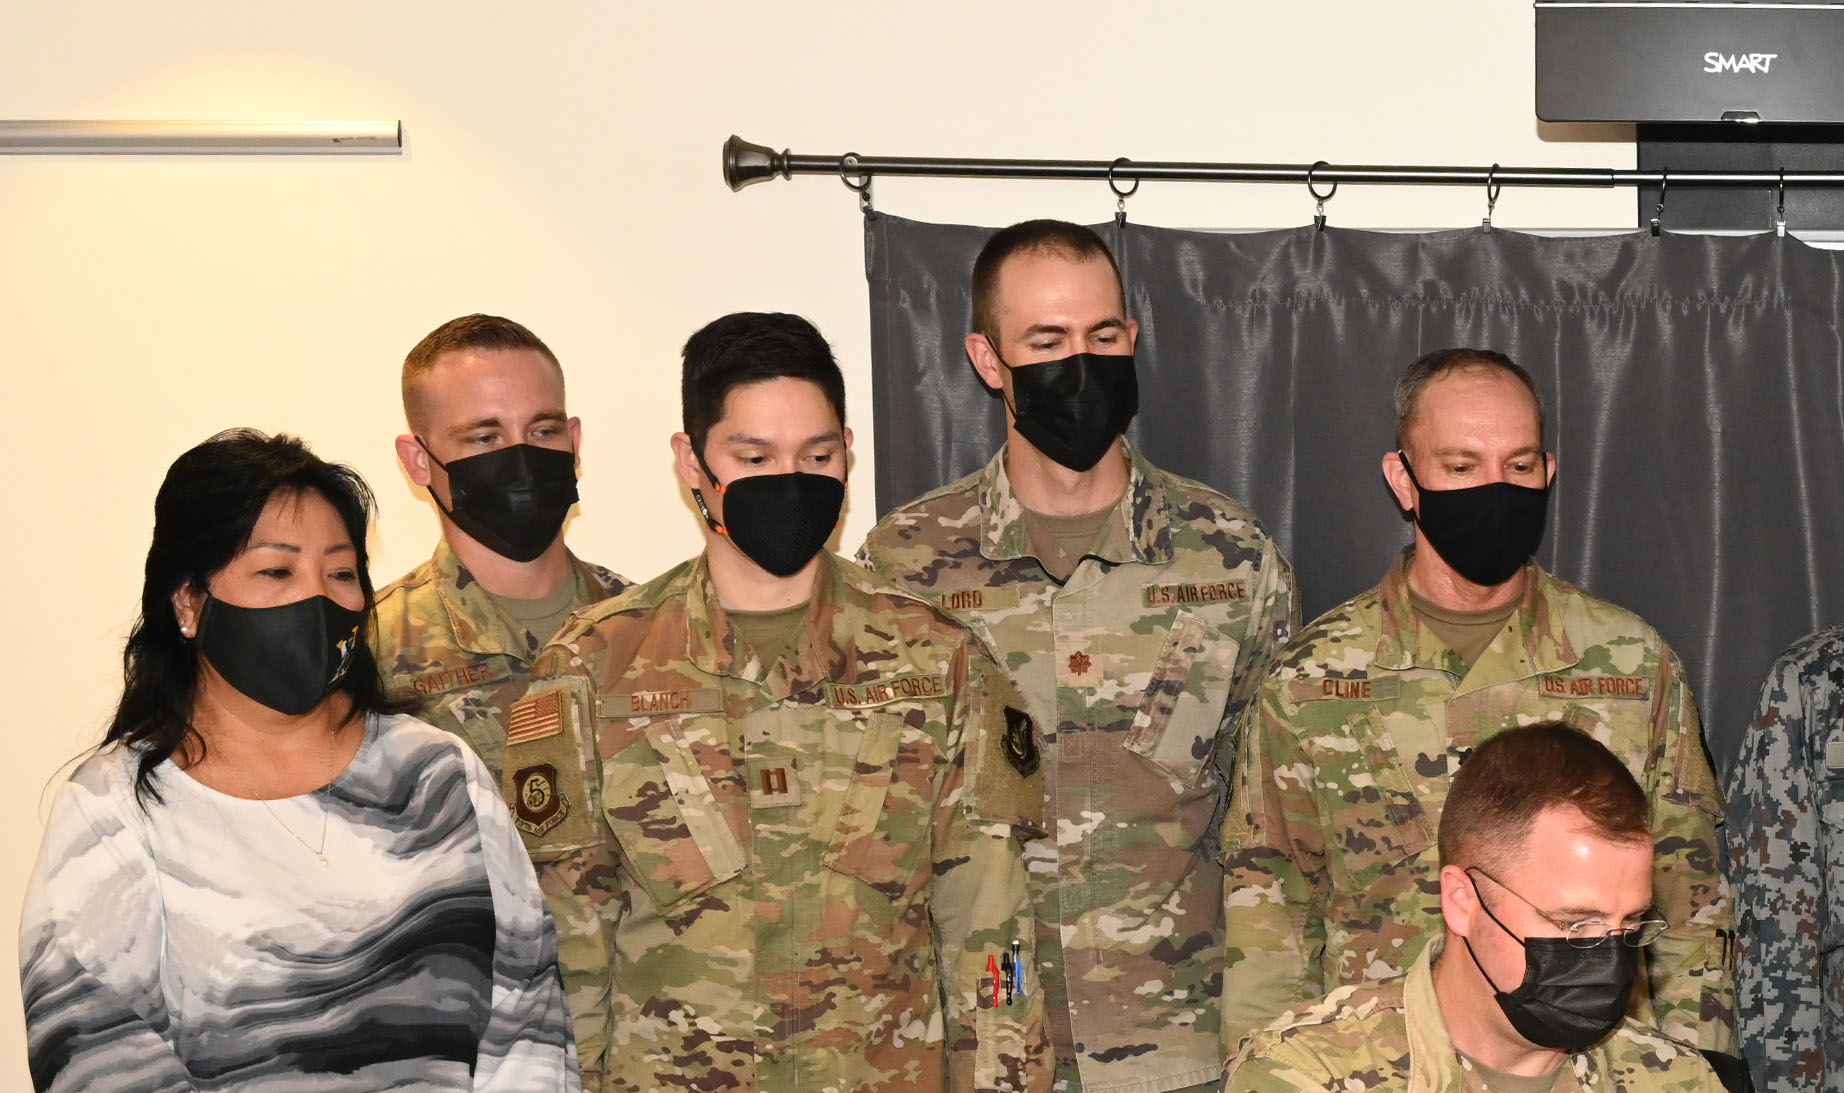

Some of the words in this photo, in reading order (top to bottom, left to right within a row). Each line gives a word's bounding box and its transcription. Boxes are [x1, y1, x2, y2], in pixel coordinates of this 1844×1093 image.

[1703, 52, 1778, 73] SMART
[941, 590, 982, 610] LORD
[1177, 585, 1199, 603] AIR
[1200, 581, 1246, 601] FORCE
[413, 662, 495, 694] GAITHER
[1322, 679, 1371, 698] CLINE
[1570, 678, 1594, 696] AIR
[1597, 677, 1646, 696] FORCE
[834, 687, 862, 705] U.S.
[865, 684, 889, 704] AIR
[890, 676, 944, 698] FORCE
[529, 778, 545, 808] 5
